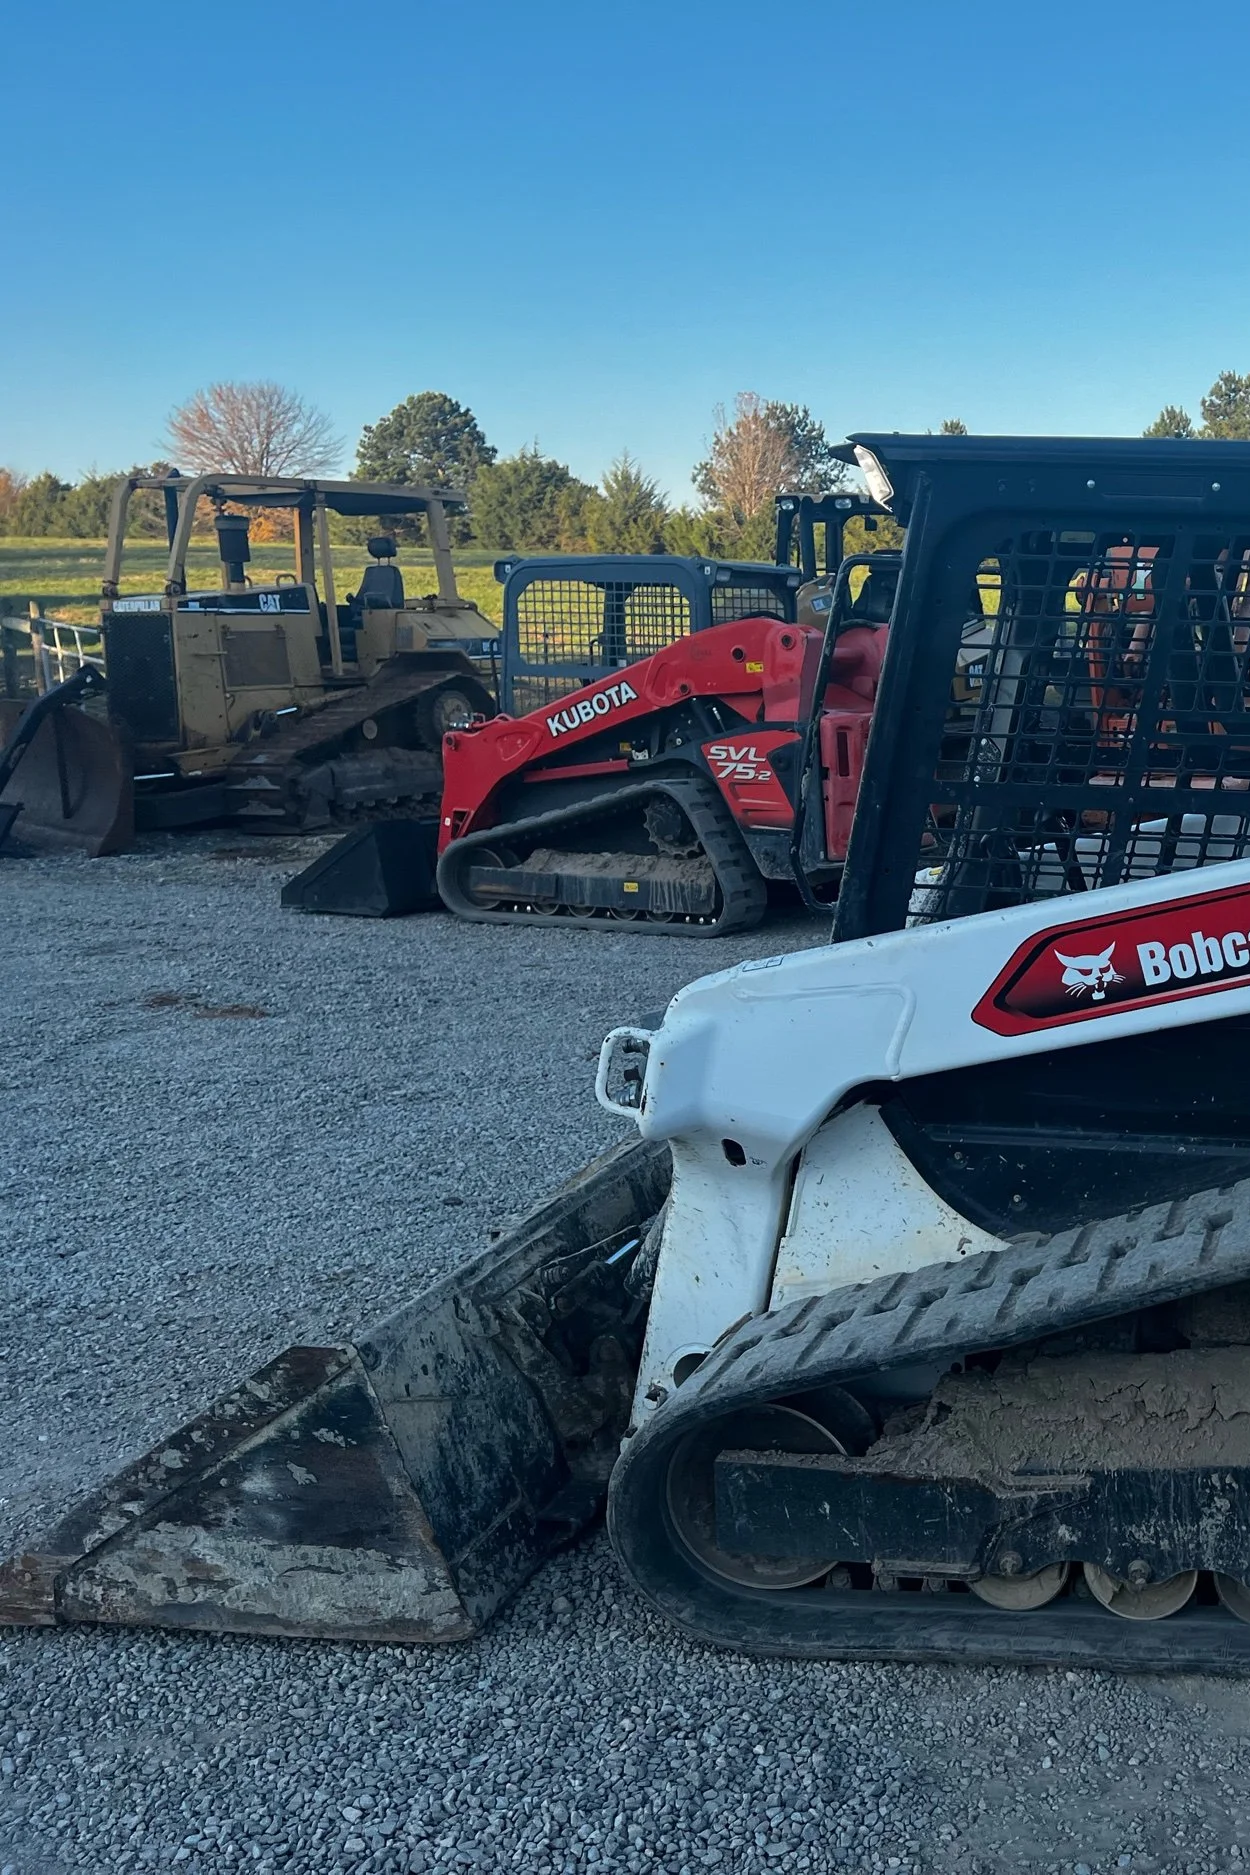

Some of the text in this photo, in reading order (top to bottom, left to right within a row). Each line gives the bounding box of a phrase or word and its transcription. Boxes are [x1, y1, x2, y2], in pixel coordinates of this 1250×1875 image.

[259, 594, 281, 612] CAT
[547, 681, 638, 737] KUBOTA
[707, 745, 767, 762] SVL
[716, 762, 772, 781] 75-2
